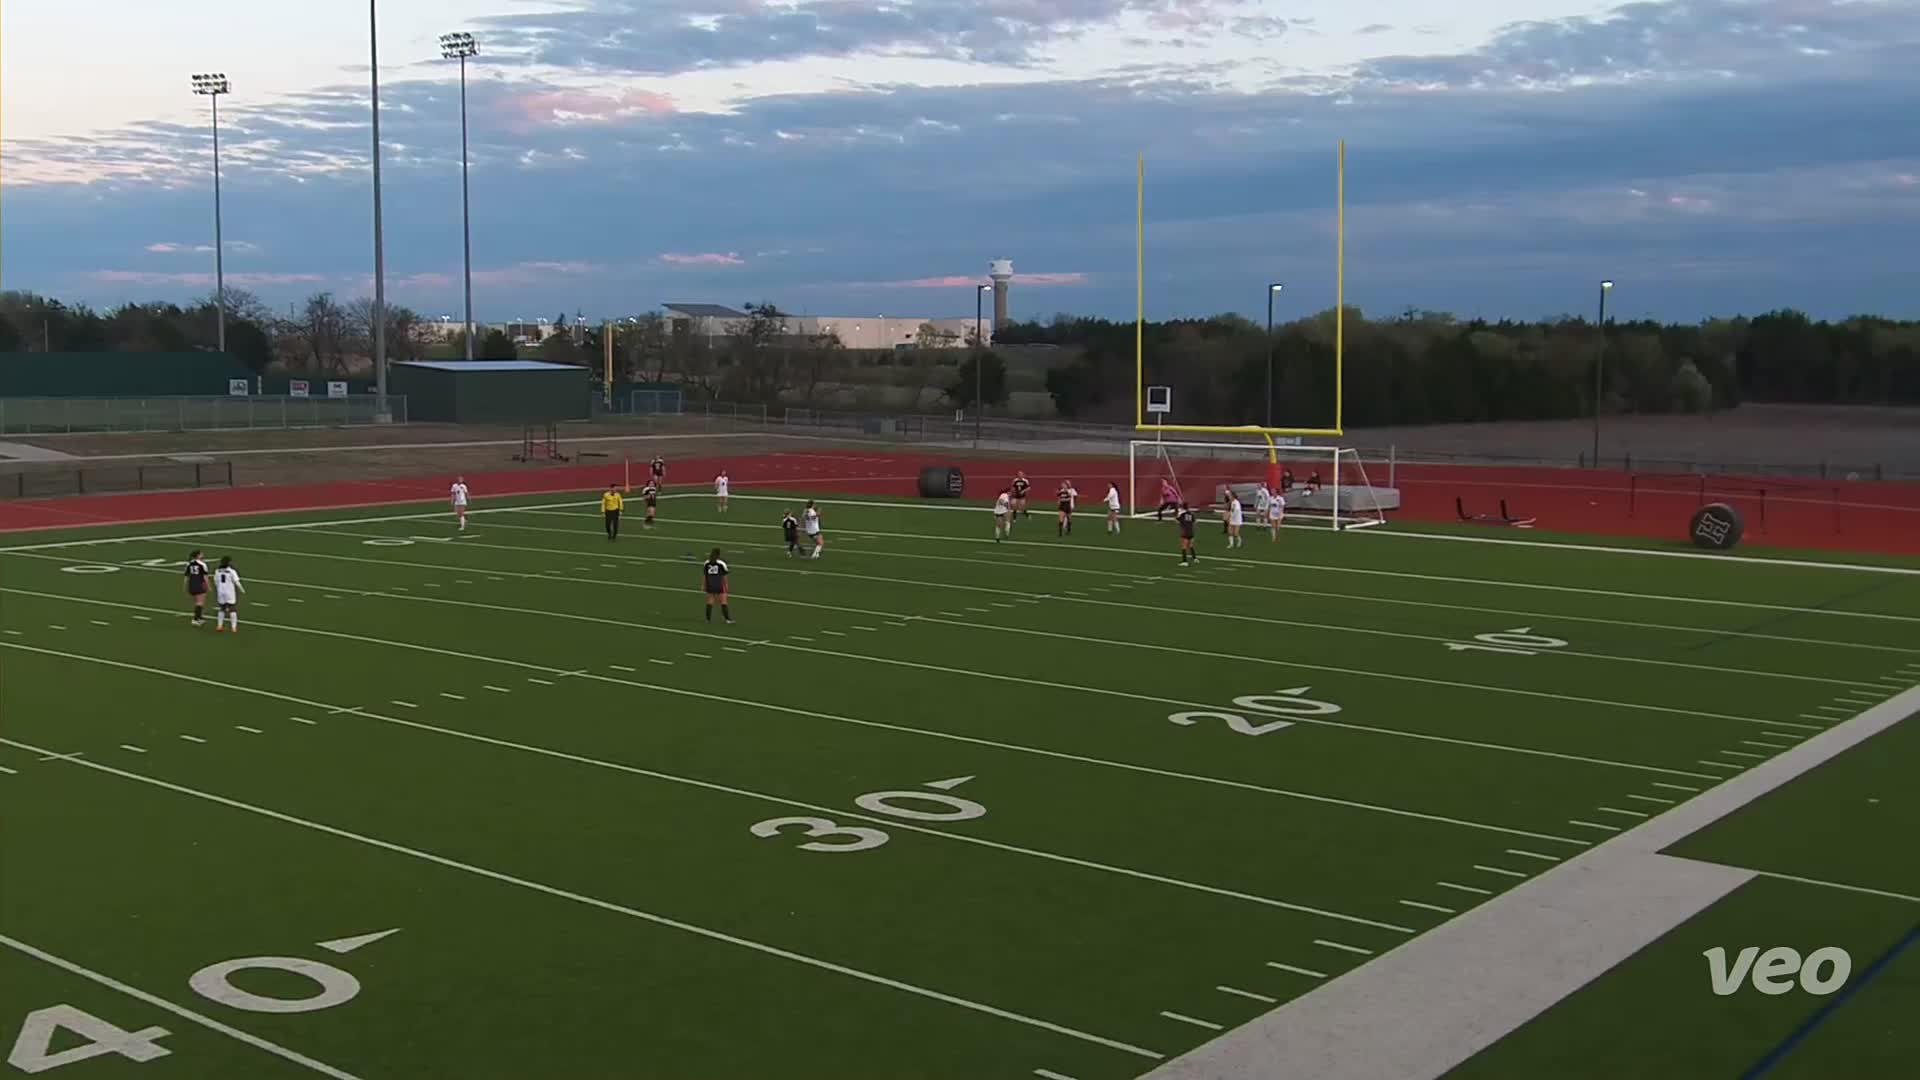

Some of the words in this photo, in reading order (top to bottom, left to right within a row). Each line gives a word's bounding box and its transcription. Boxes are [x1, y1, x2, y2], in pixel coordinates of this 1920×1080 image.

[1695, 512, 1731, 545] H
[707, 564, 719, 575] 20
[1441, 632, 1568, 655] 10
[1167, 695, 1343, 736] 20
[750, 790, 987, 852] 30
[7, 956, 361, 1074] 40
